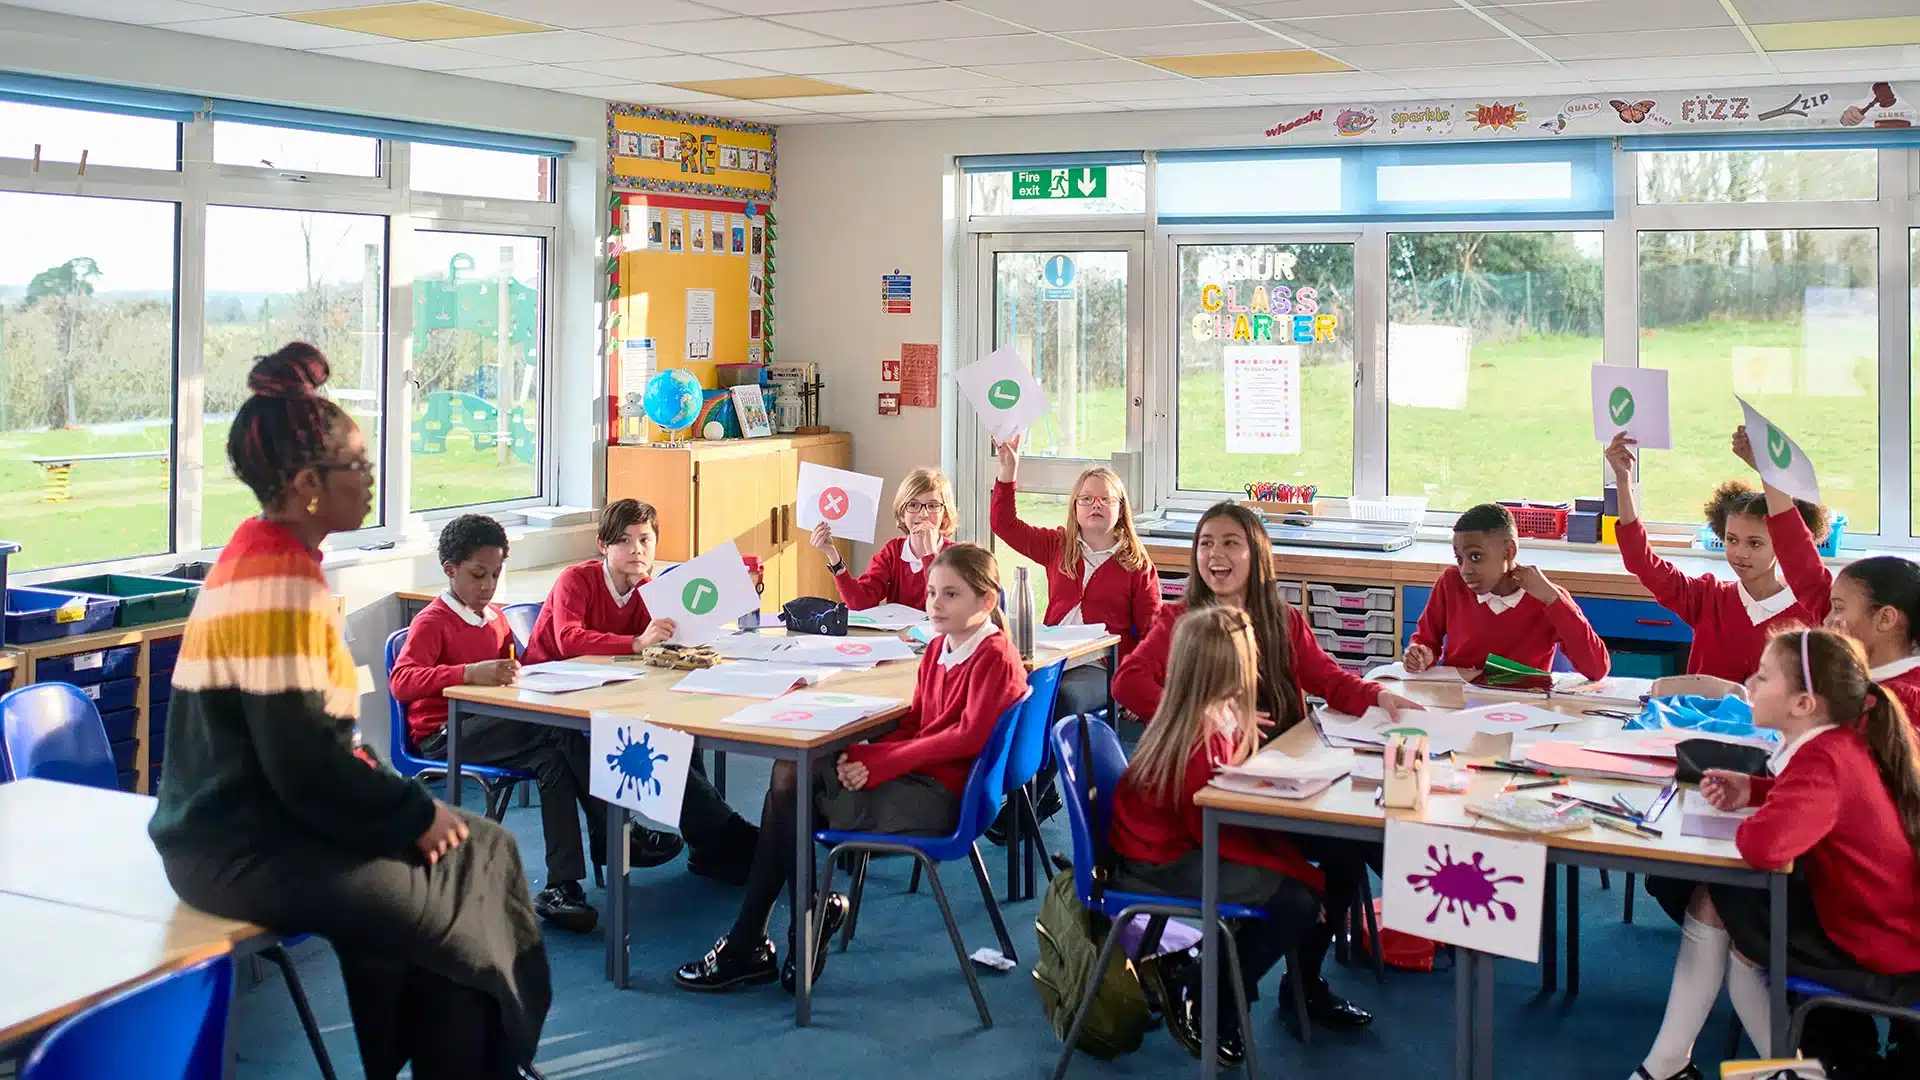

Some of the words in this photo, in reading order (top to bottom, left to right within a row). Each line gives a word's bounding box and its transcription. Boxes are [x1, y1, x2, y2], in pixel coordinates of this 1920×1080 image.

[1567, 103, 1600, 113] QUACK
[1681, 97, 1749, 121] FIZZ
[1801, 94, 1829, 110] ZIP
[1265, 109, 1324, 137] whoosh!
[1391, 106, 1450, 128] sparkle
[680, 131, 717, 175] RE
[1018, 172, 1041, 183] Fire
[1018, 184, 1041, 197] exit
[1229, 252, 1298, 281] OUR
[1201, 283, 1319, 316] CLASS
[1191, 313, 1338, 344] CHARTER
